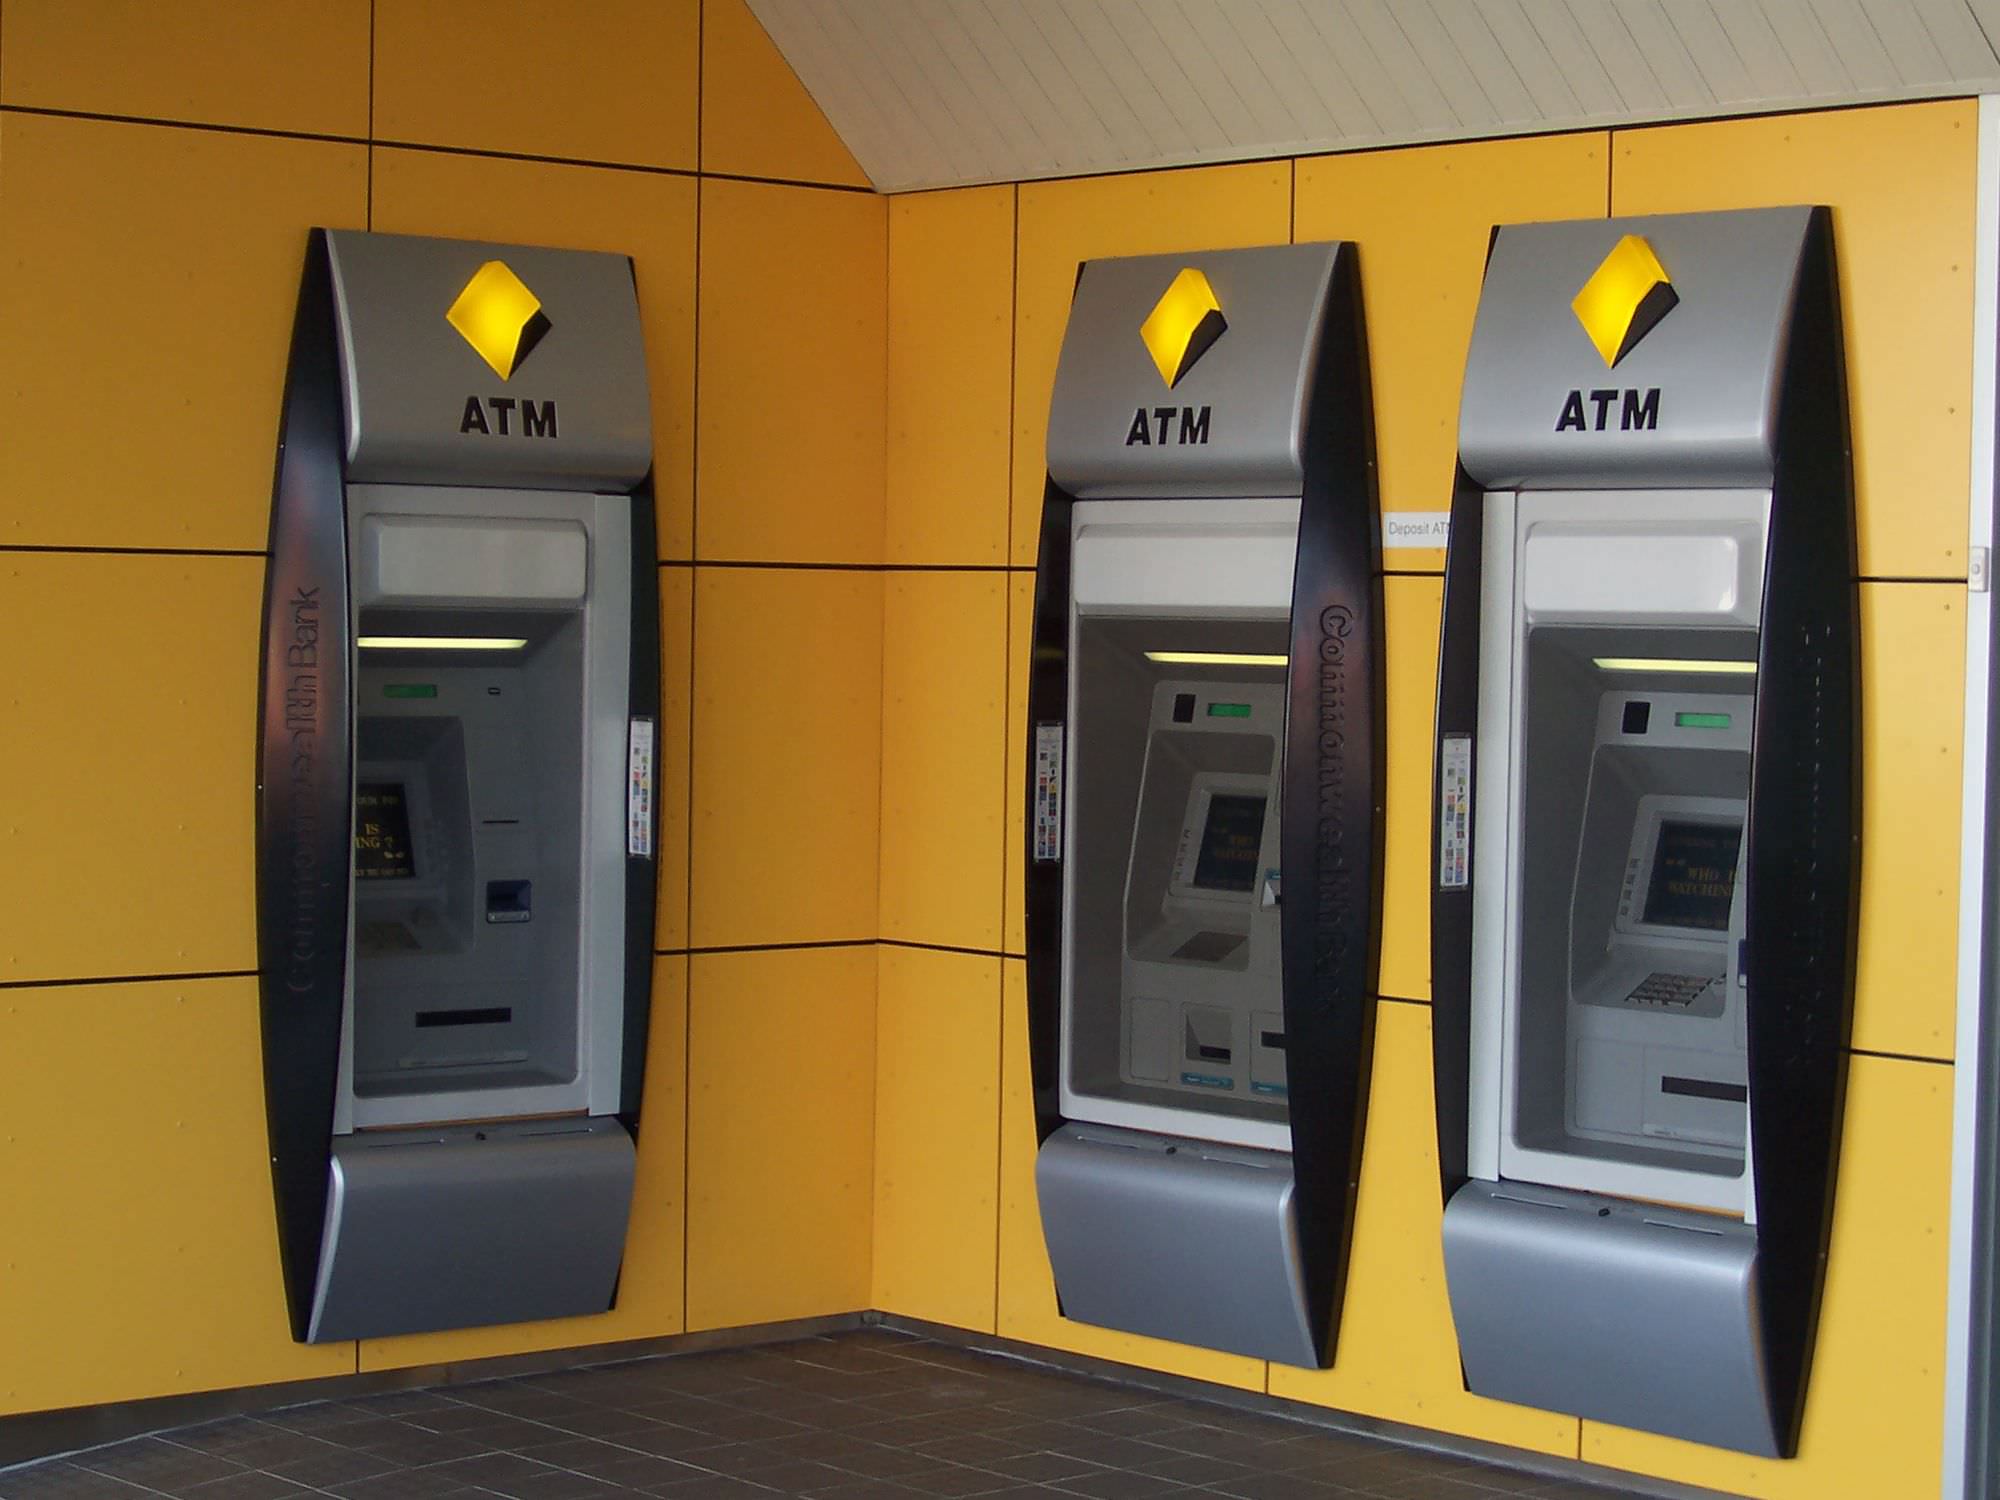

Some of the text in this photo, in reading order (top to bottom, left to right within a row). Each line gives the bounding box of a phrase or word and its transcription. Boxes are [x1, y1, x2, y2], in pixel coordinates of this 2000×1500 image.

[460, 396, 558, 438] ATM
[1126, 406, 1211, 446] ATM
[1555, 388, 1661, 431] ATM
[1388, 521, 1429, 536] Deposit
[287, 585, 320, 669] Bank
[1318, 604, 1353, 928] Commonwealth
[364, 823, 380, 836] IS
